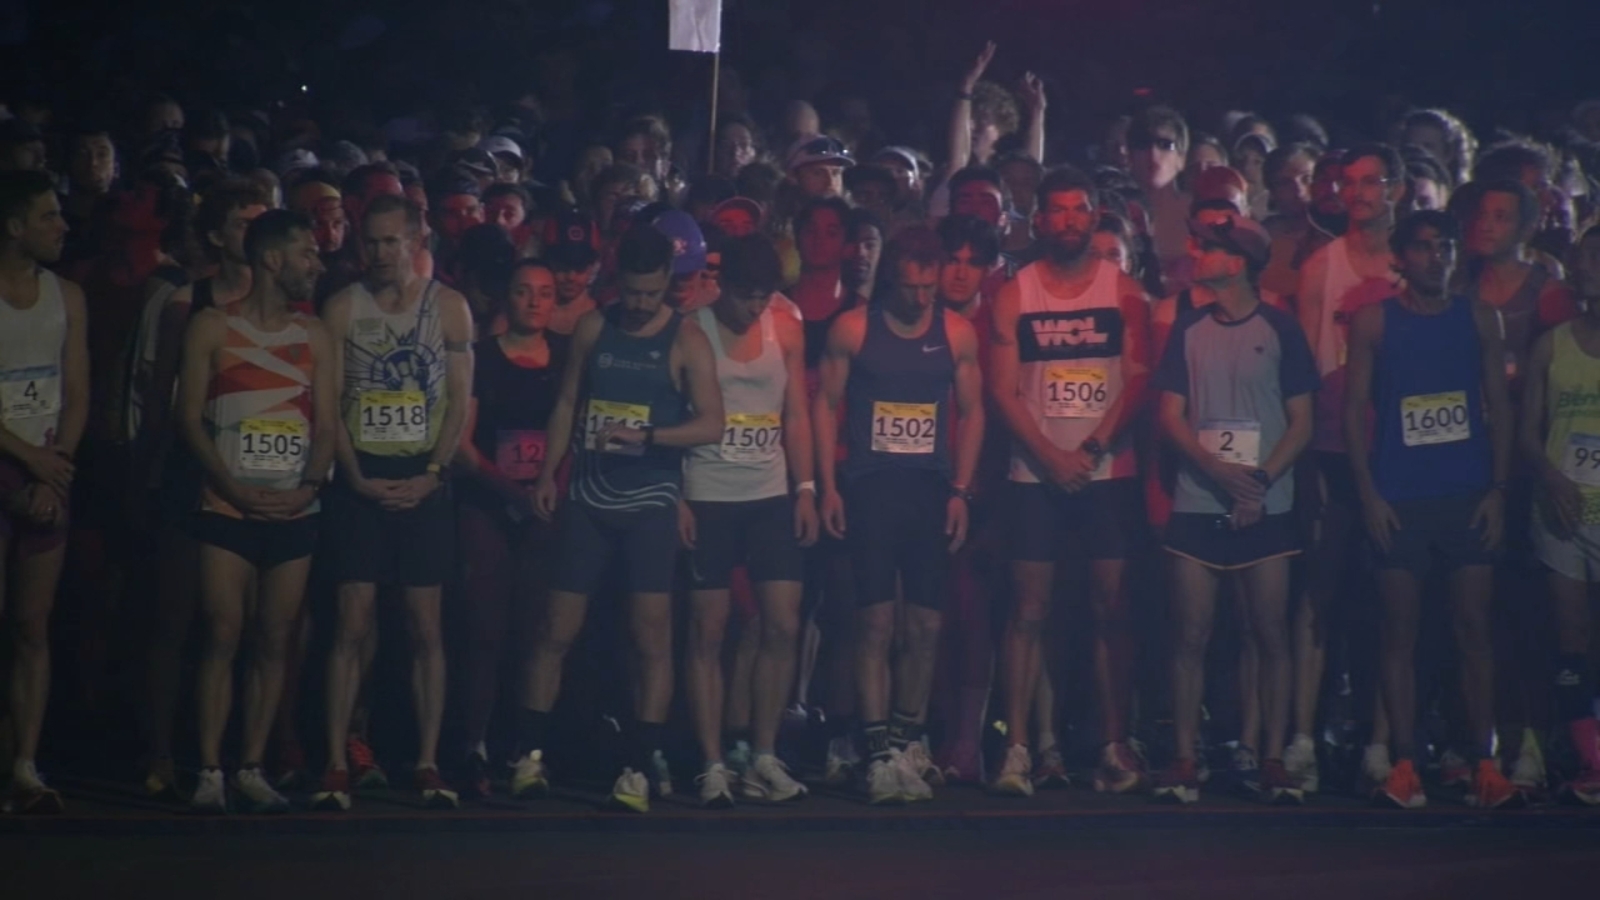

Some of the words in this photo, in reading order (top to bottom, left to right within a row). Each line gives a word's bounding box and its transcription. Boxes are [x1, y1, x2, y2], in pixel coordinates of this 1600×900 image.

[1030, 316, 1109, 347] WOL
[24, 380, 39, 401] 4
[1047, 381, 1107, 402] 1506
[363, 405, 425, 427] 1518
[875, 416, 935, 438] 1502
[1405, 404, 1467, 431] 1600
[242, 432, 302, 456] 1505
[725, 426, 781, 448] 1507
[1219, 430, 1235, 451] 2
